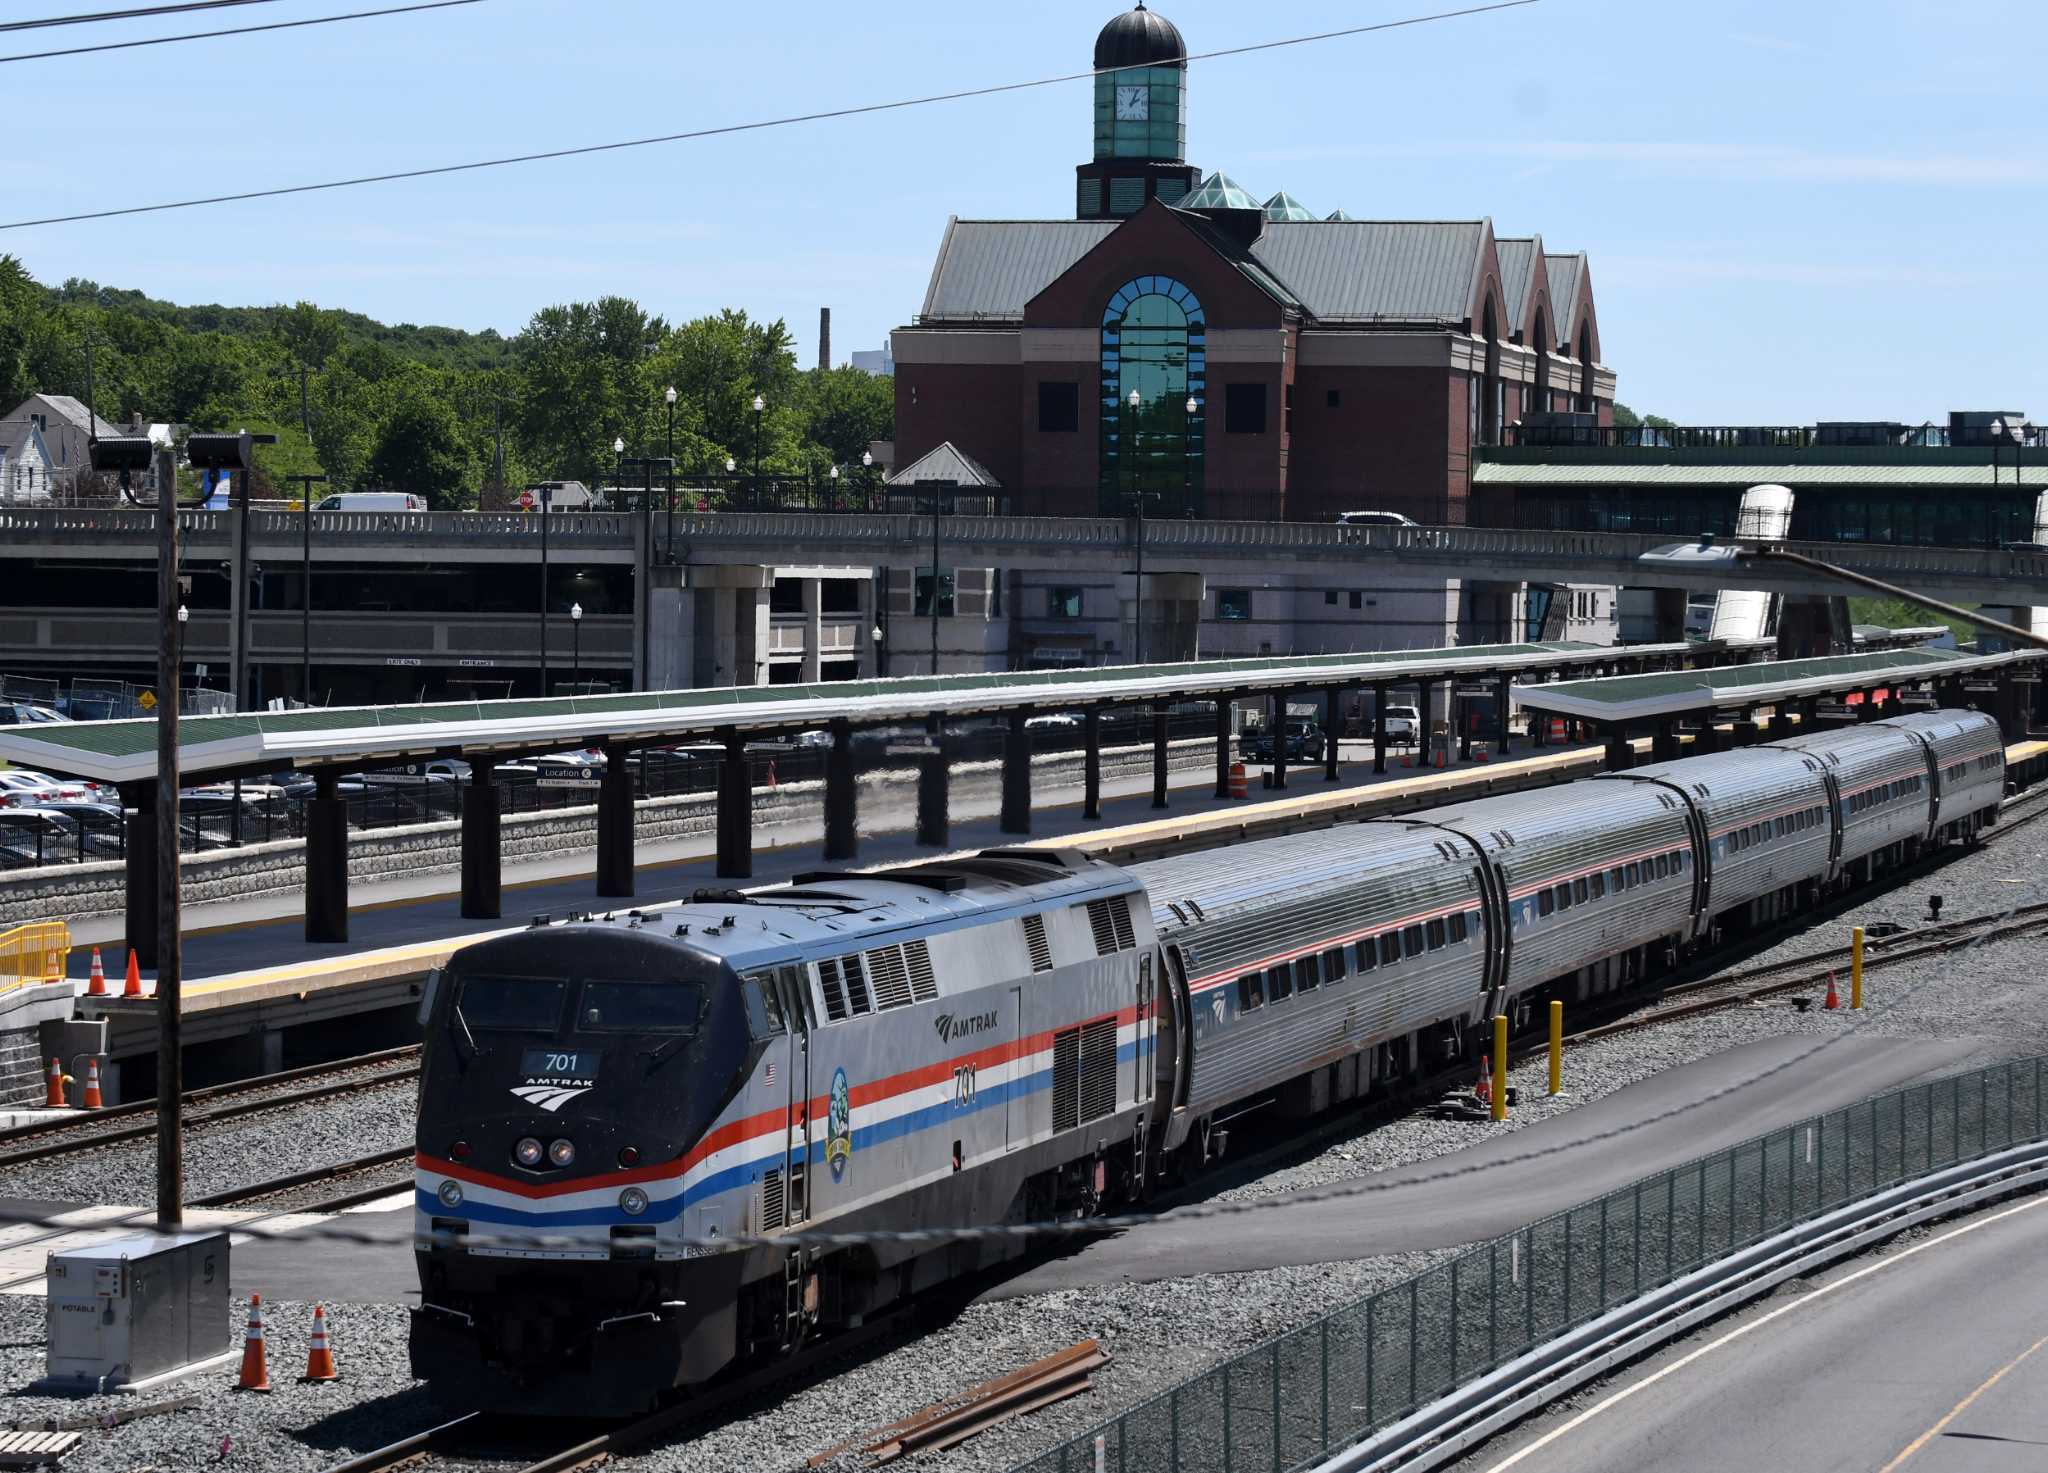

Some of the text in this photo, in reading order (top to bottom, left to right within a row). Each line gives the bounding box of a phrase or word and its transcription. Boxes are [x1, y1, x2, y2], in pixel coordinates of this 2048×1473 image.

[545, 768, 579, 777] Location
[952, 1010, 997, 1039] AMTRAK
[545, 1054, 577, 1071] 701
[526, 1078, 593, 1087] AMTRAK
[953, 1062, 976, 1109] 701
[62, 1304, 96, 1312] POTABLE
